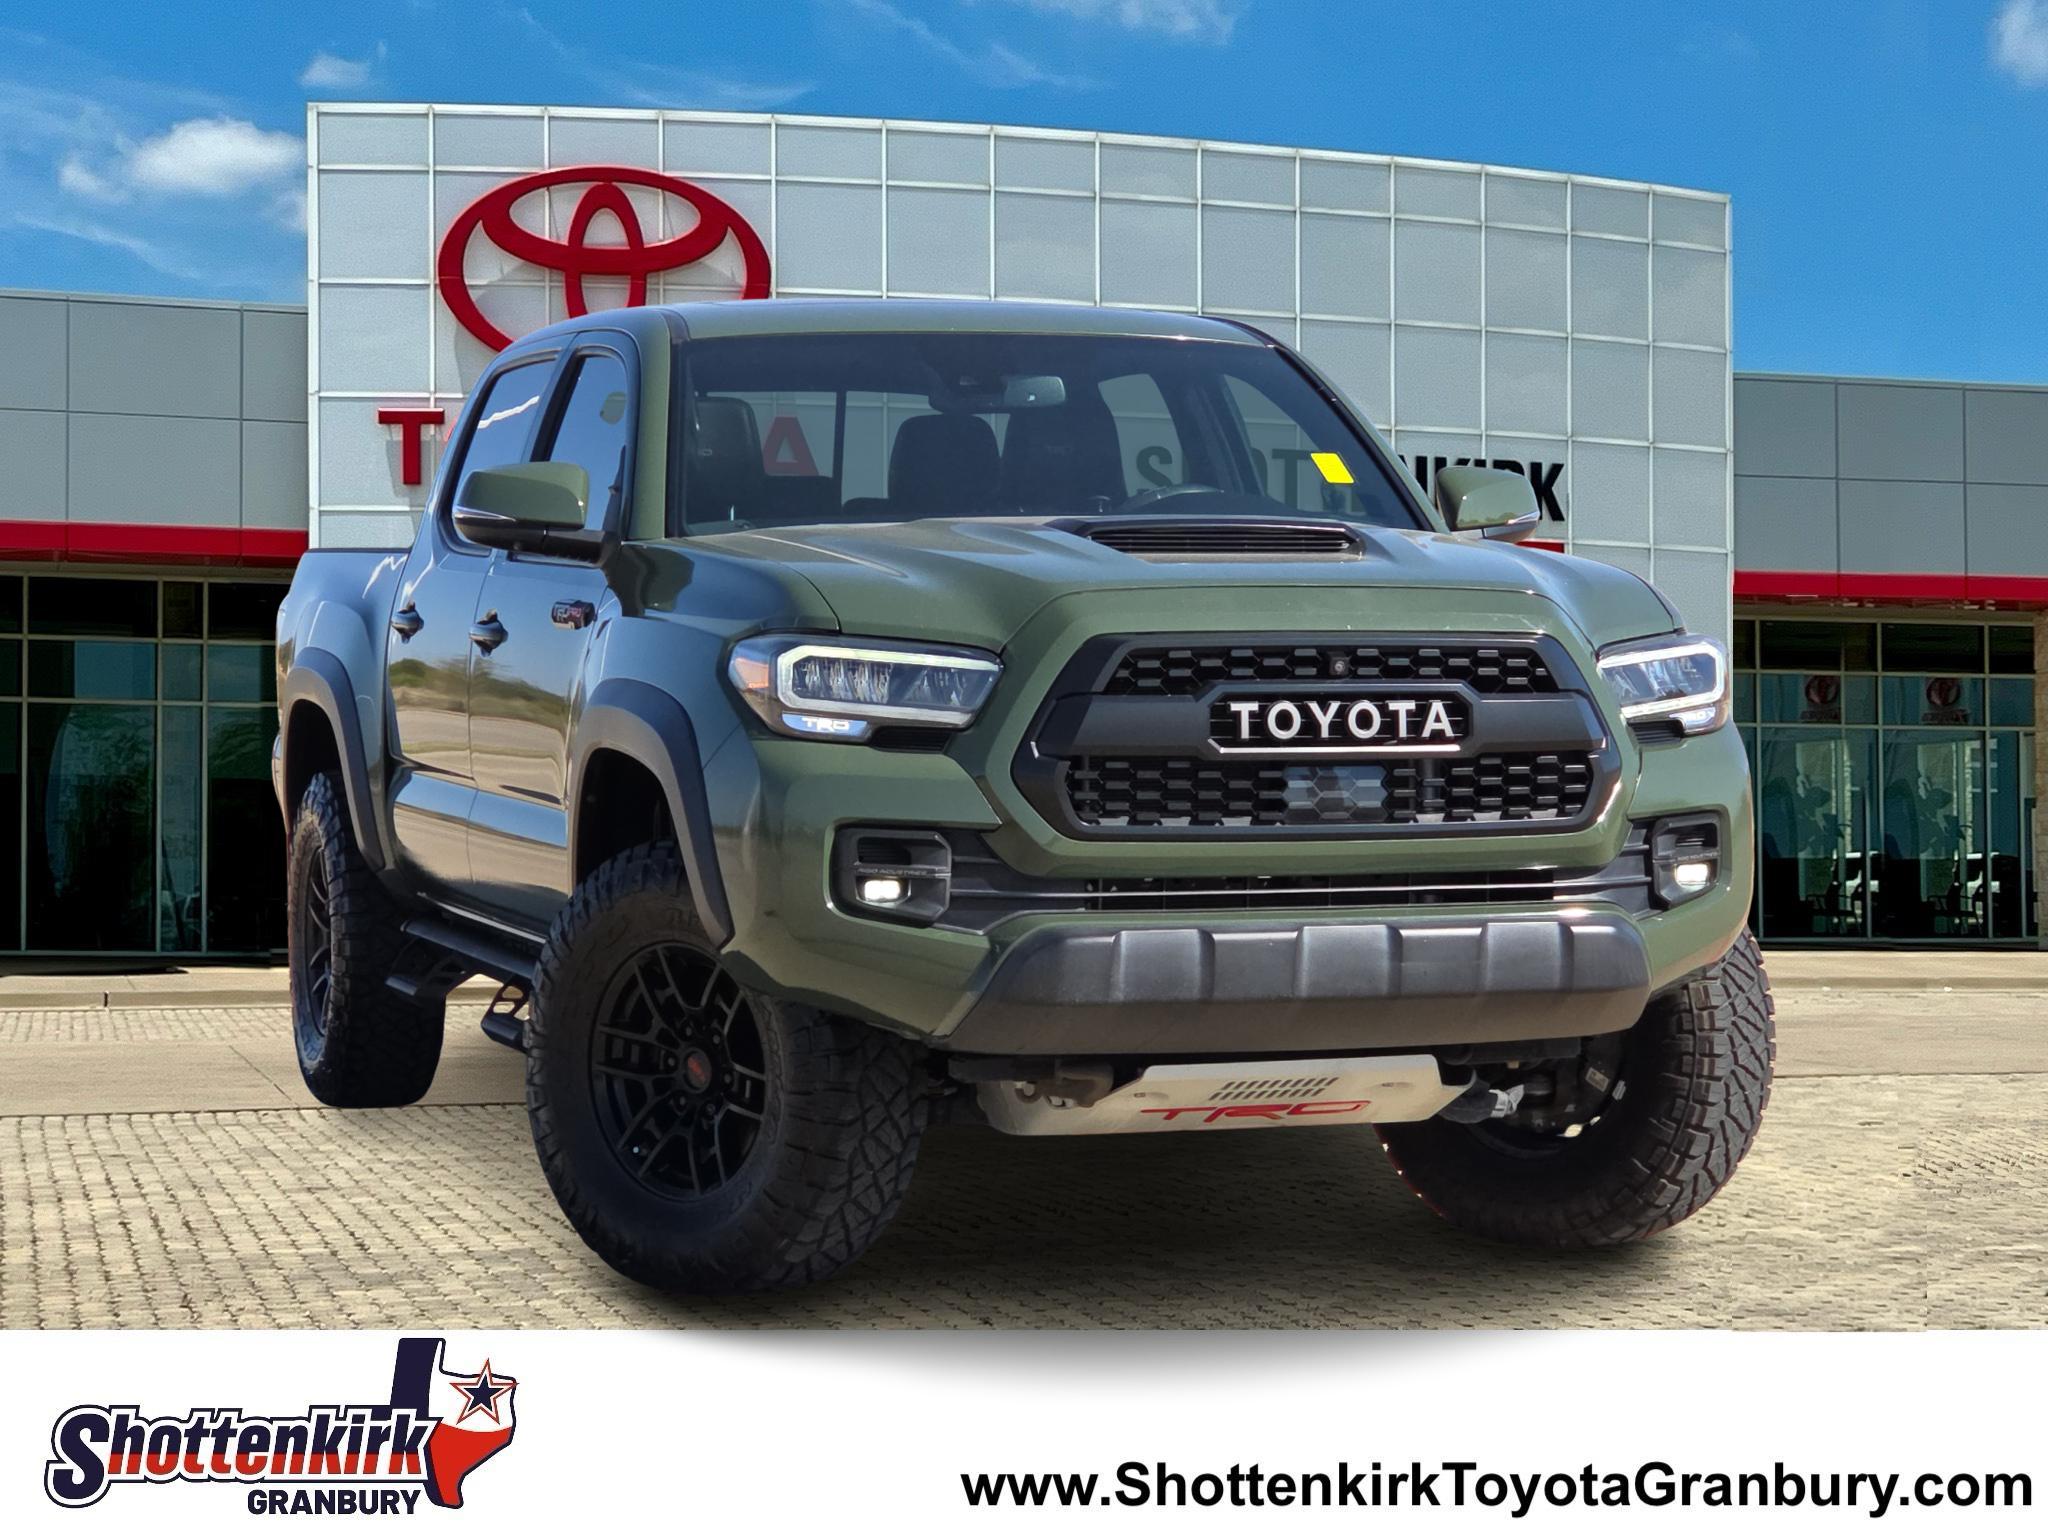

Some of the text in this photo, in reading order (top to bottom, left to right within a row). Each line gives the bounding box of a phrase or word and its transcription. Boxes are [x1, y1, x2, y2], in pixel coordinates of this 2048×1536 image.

[802, 716, 850, 733] TRD
[1231, 699, 1454, 739] TOYOTA
[1141, 1101, 1370, 1123] TRD
